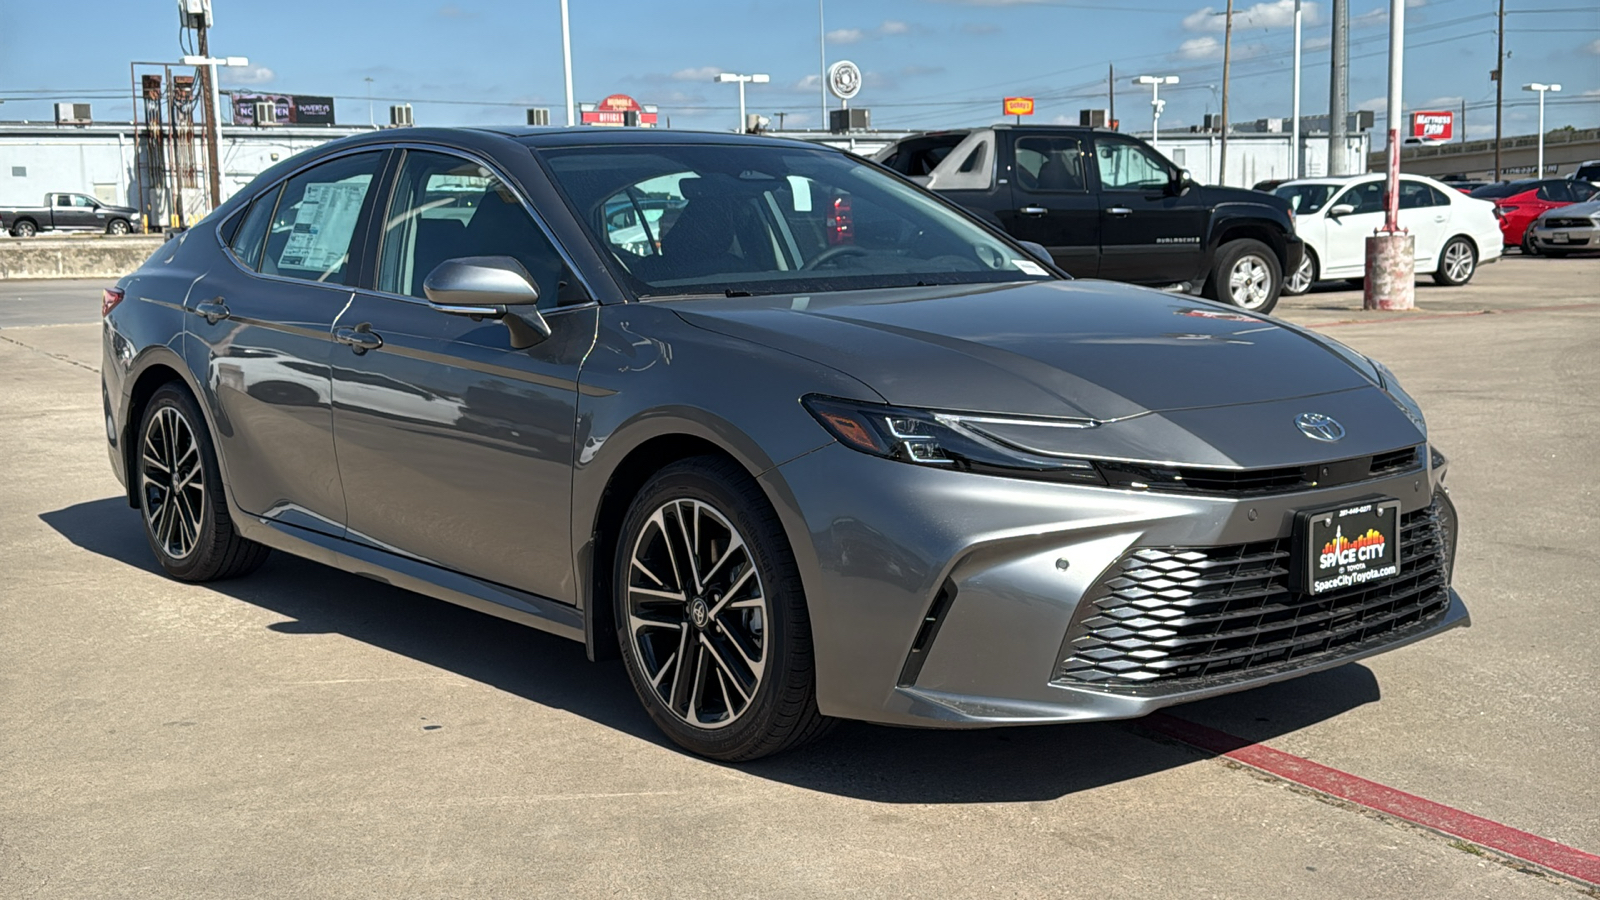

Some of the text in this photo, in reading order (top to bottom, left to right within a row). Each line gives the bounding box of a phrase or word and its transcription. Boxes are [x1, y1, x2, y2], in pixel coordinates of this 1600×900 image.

[1320, 542, 1385, 569] SPACE CITY
[1346, 563, 1366, 572] TOYOTA
[1314, 565, 1396, 592] SpaceCityToyota.com
